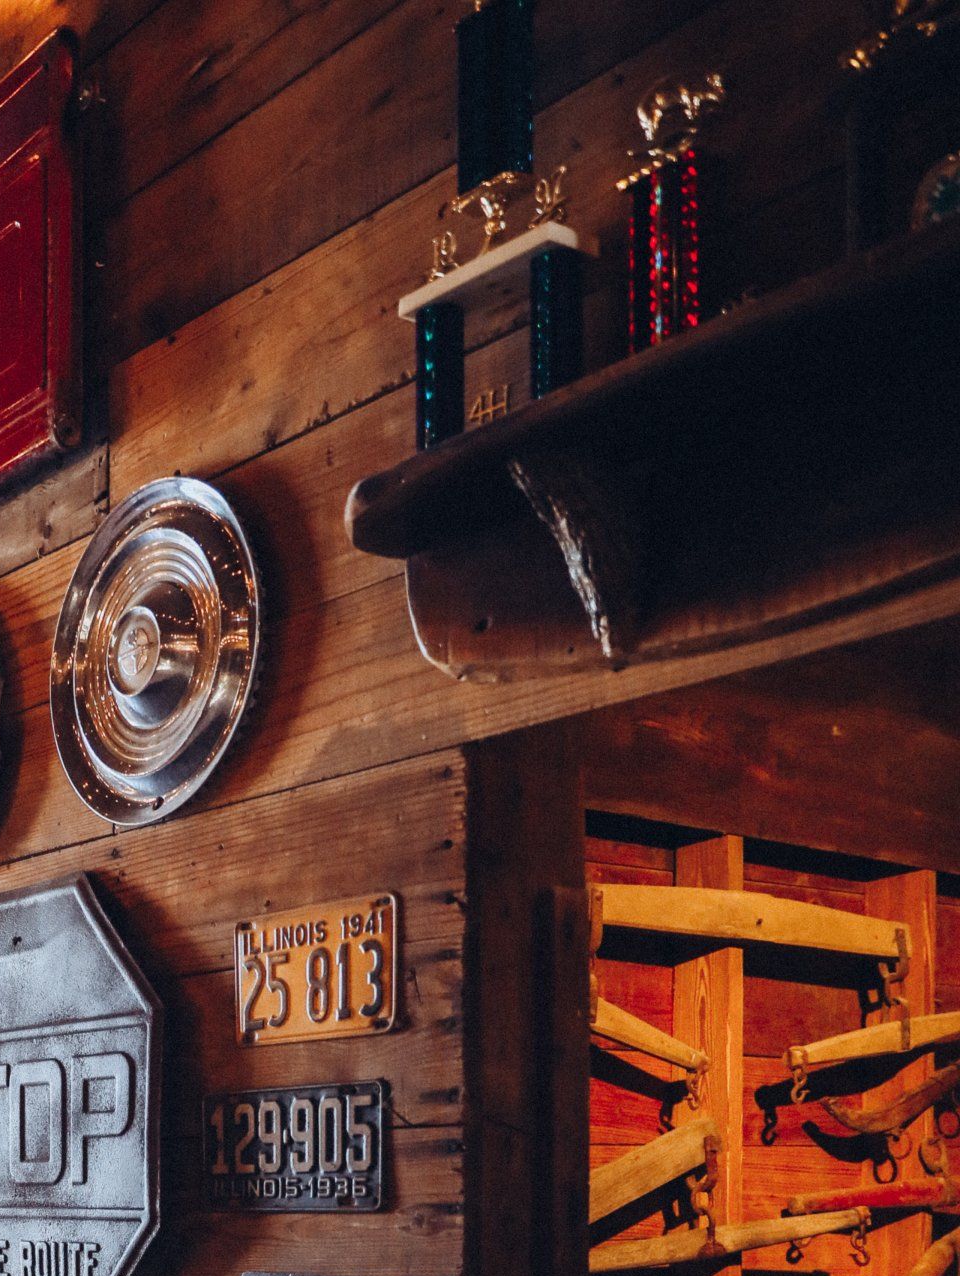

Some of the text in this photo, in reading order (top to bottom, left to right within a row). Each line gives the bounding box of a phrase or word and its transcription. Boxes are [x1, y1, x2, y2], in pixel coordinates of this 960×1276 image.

[241, 909, 385, 956] ILLINOIS 1941
[241, 938, 385, 1033] 25 813
